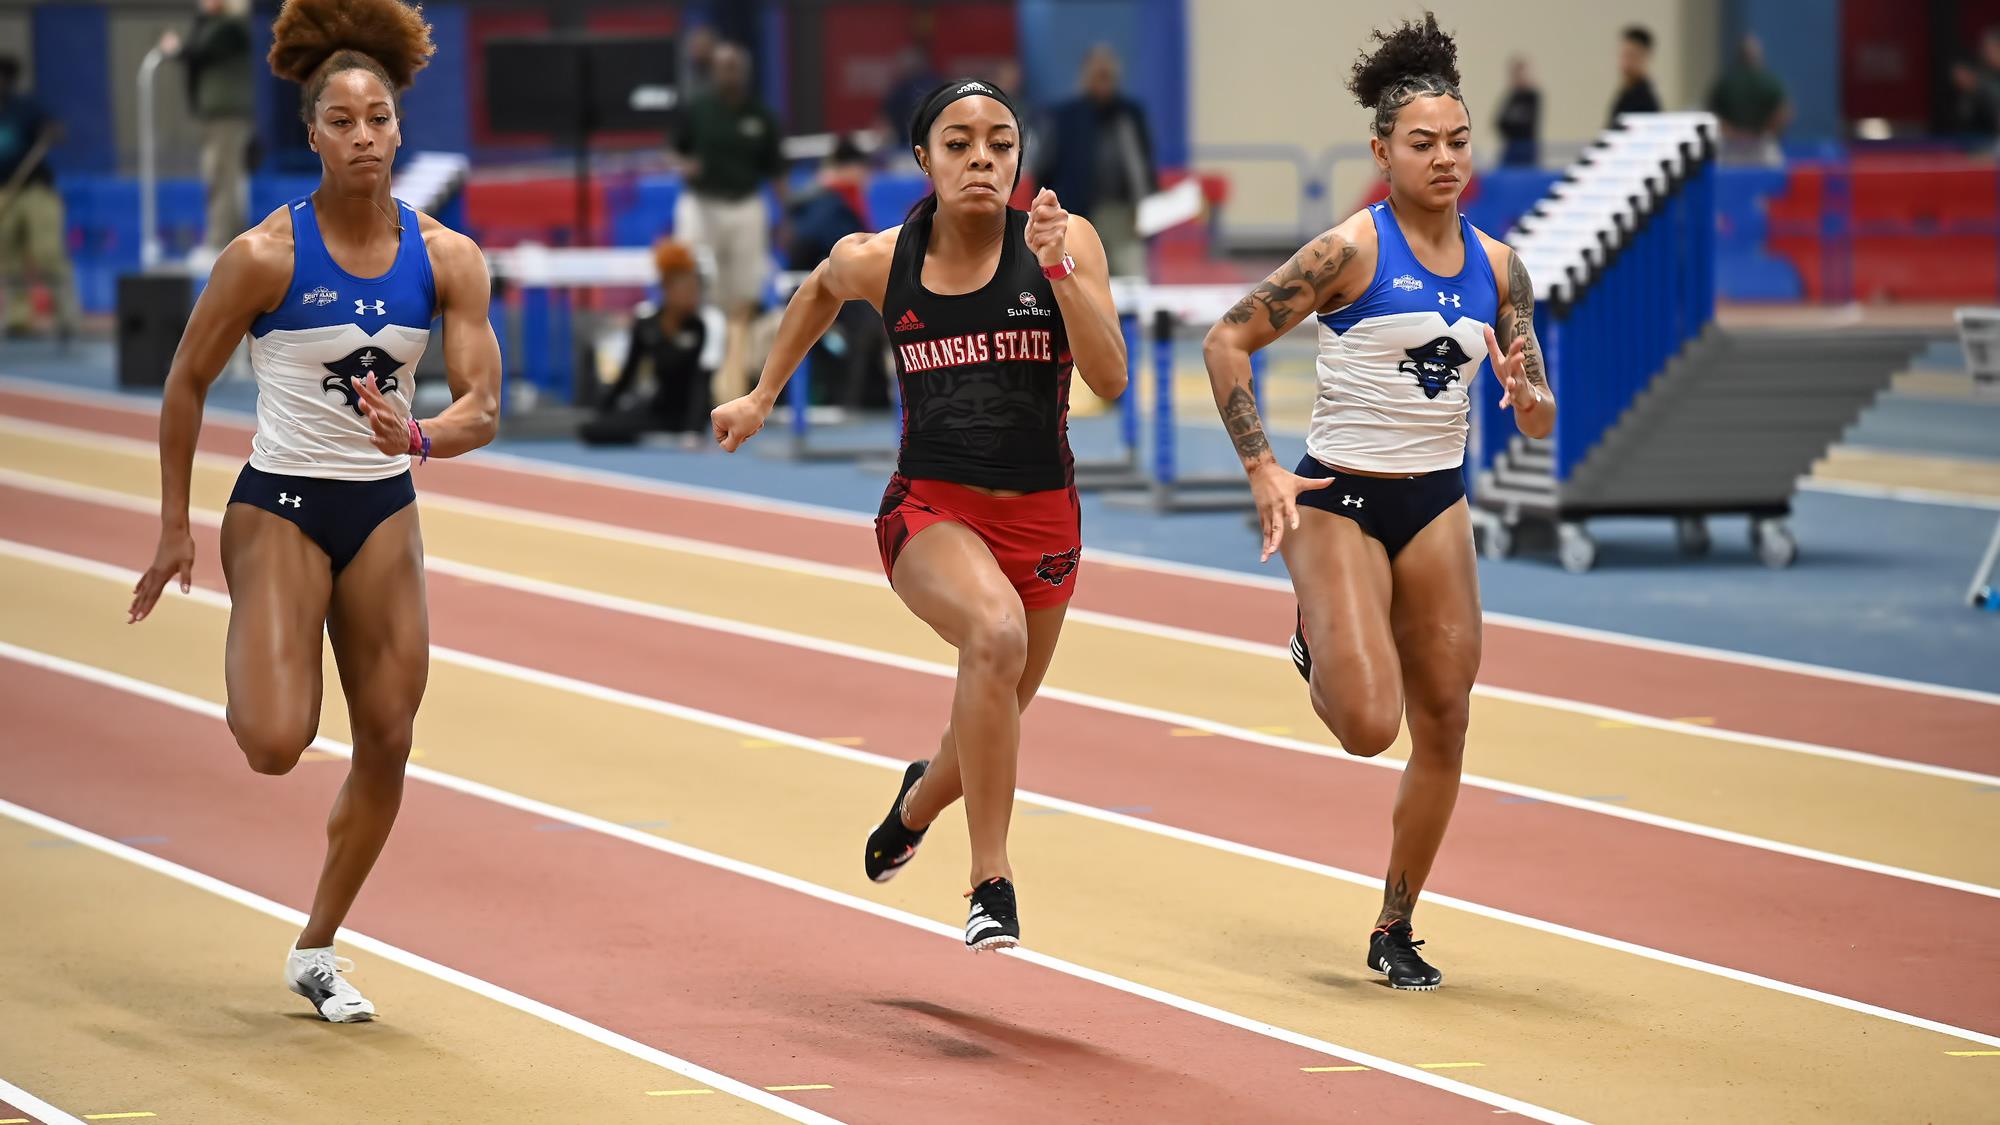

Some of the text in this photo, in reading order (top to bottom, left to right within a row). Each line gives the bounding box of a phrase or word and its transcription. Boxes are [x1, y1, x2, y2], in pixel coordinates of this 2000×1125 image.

[895, 322, 927, 332] adidas
[899, 330, 1051, 373] ARKANSAS STATE
